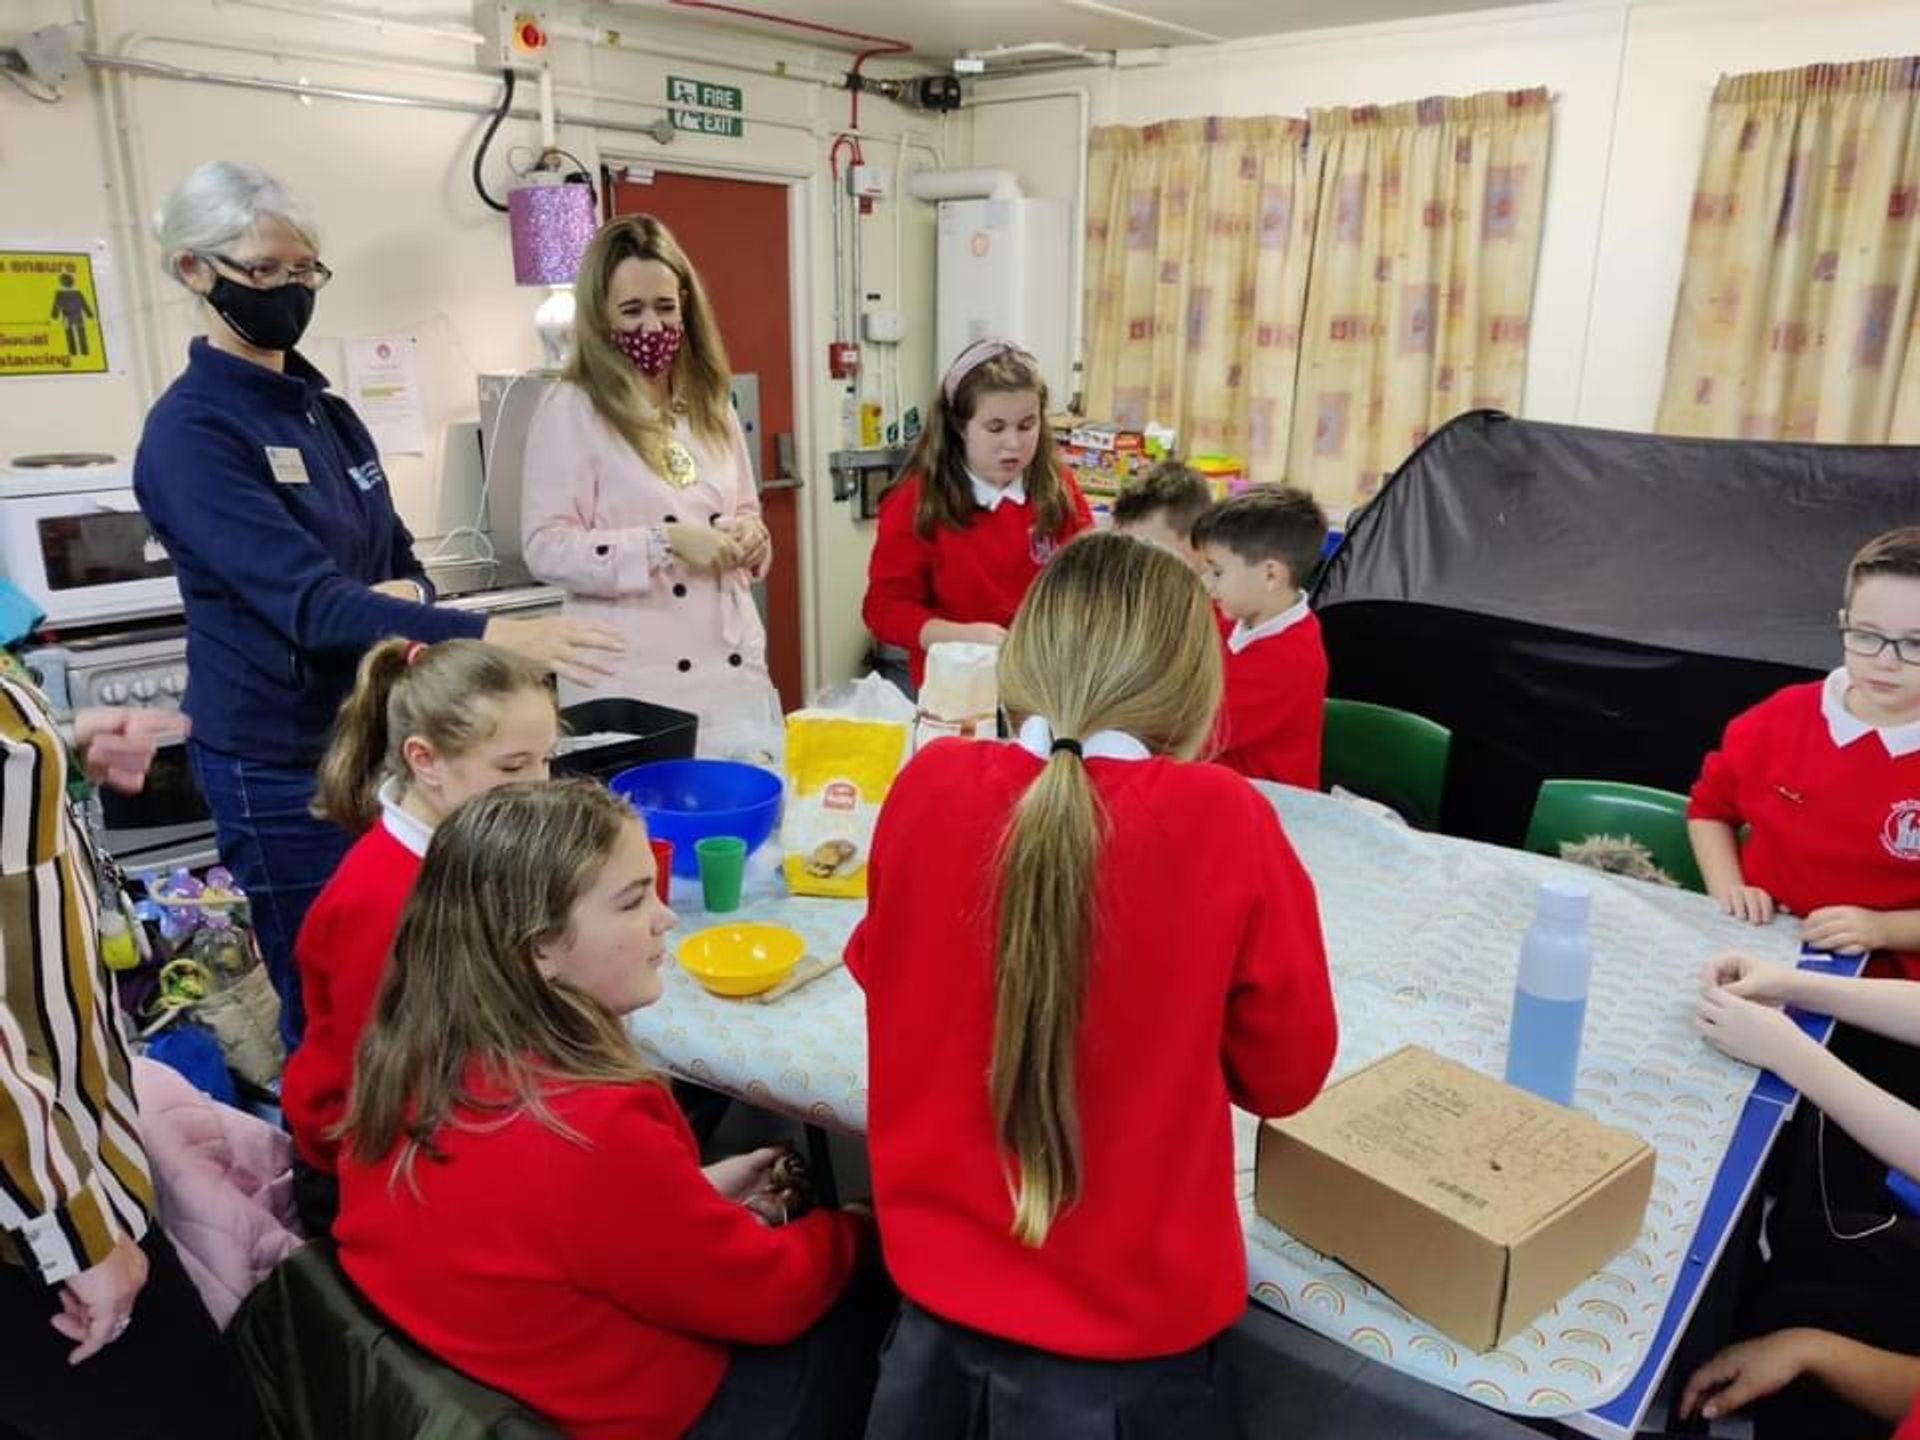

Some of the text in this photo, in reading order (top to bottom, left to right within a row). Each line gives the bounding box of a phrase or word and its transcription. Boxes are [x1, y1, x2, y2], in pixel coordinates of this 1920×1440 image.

[703, 87, 735, 110] FIRE
[703, 111, 734, 134] EXIT
[10, 260, 77, 274] ensure
